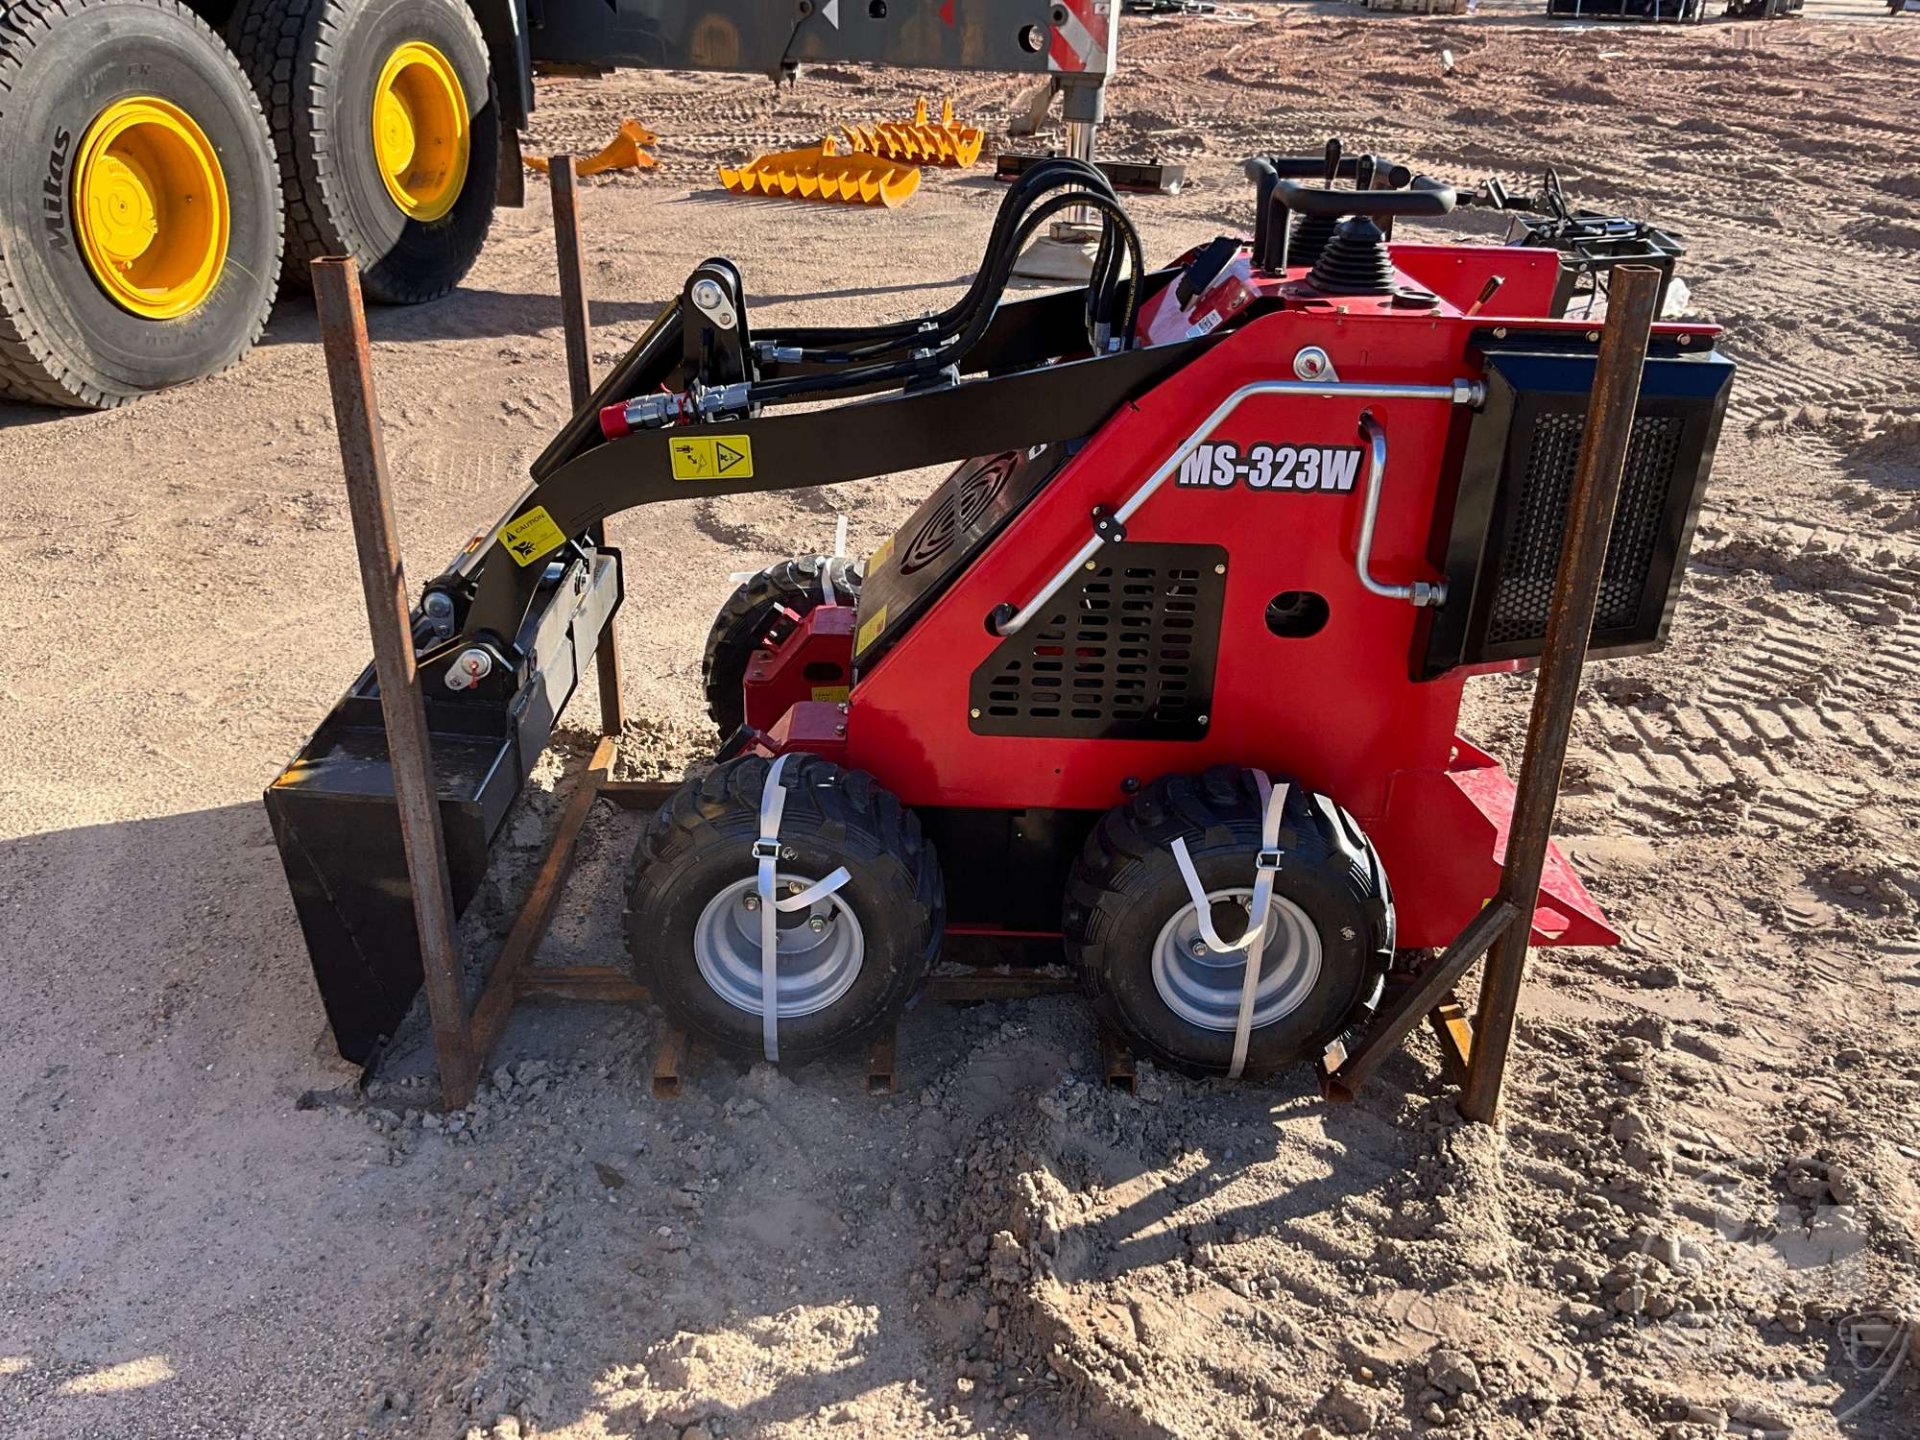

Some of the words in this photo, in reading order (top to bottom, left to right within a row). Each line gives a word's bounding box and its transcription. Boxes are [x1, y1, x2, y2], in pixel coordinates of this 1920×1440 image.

[44, 125, 73, 259] Mitas
[1178, 443, 1362, 491] MS-323W
[515, 514, 545, 534] CAUTION
